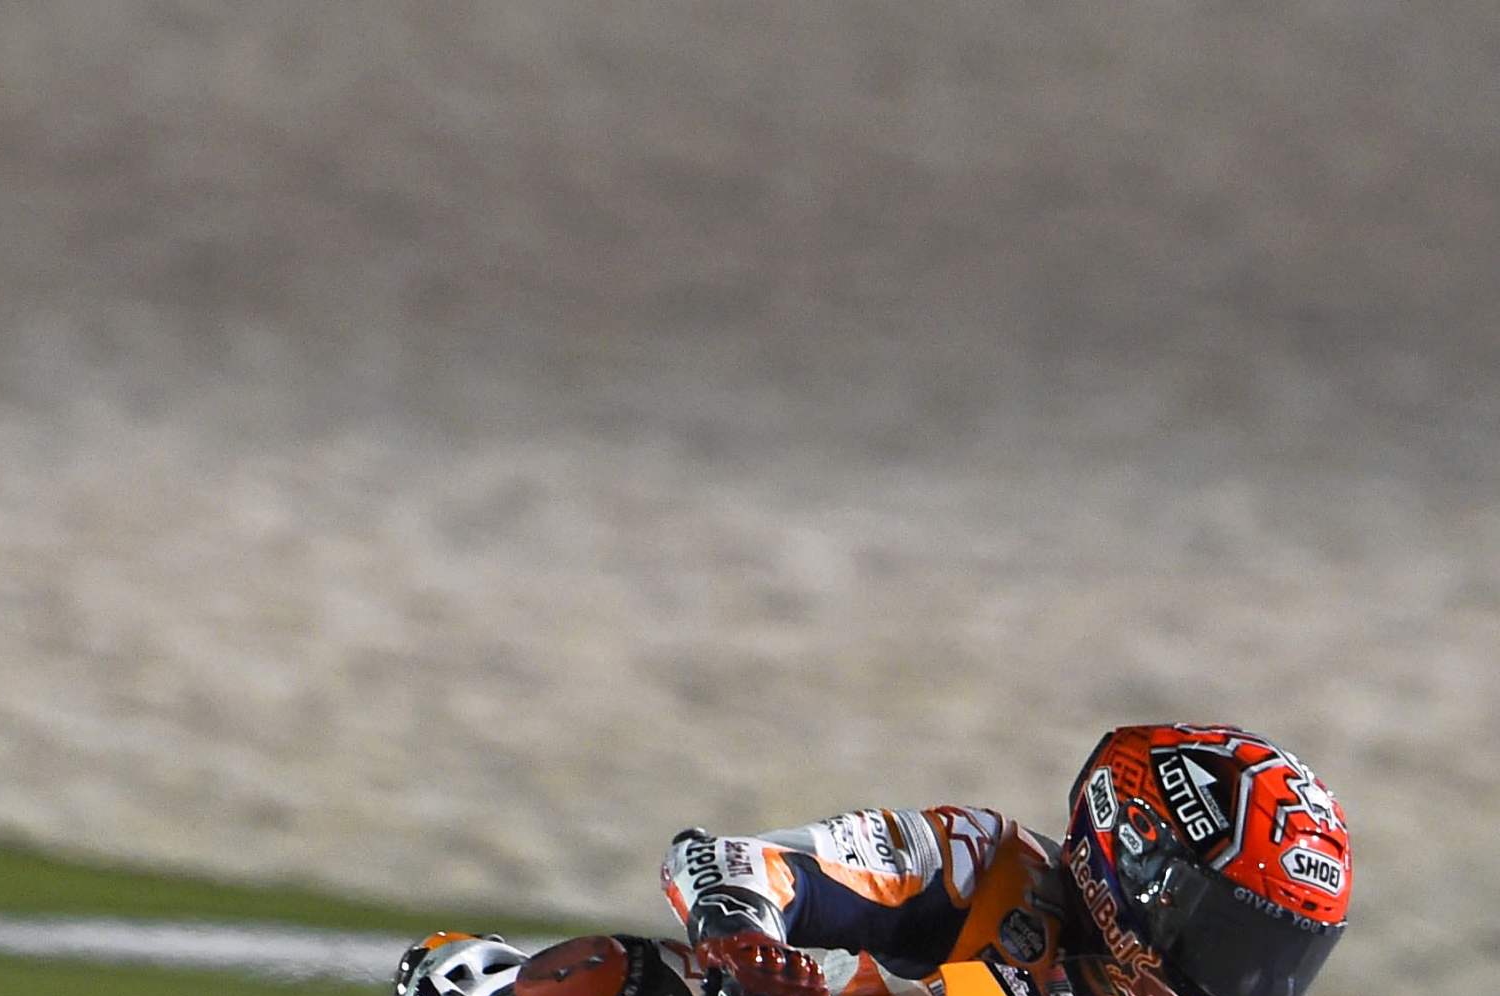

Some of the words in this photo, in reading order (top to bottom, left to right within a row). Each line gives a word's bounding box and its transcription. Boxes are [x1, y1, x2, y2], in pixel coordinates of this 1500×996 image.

[1089, 777, 1113, 826] SHOEI
[1158, 755, 1214, 842] LOTUS
[686, 836, 723, 890] REPSO
[1294, 854, 1342, 892] SHOEI
[1234, 886, 1284, 921] GIVES
[1291, 912, 1324, 936] YOU
